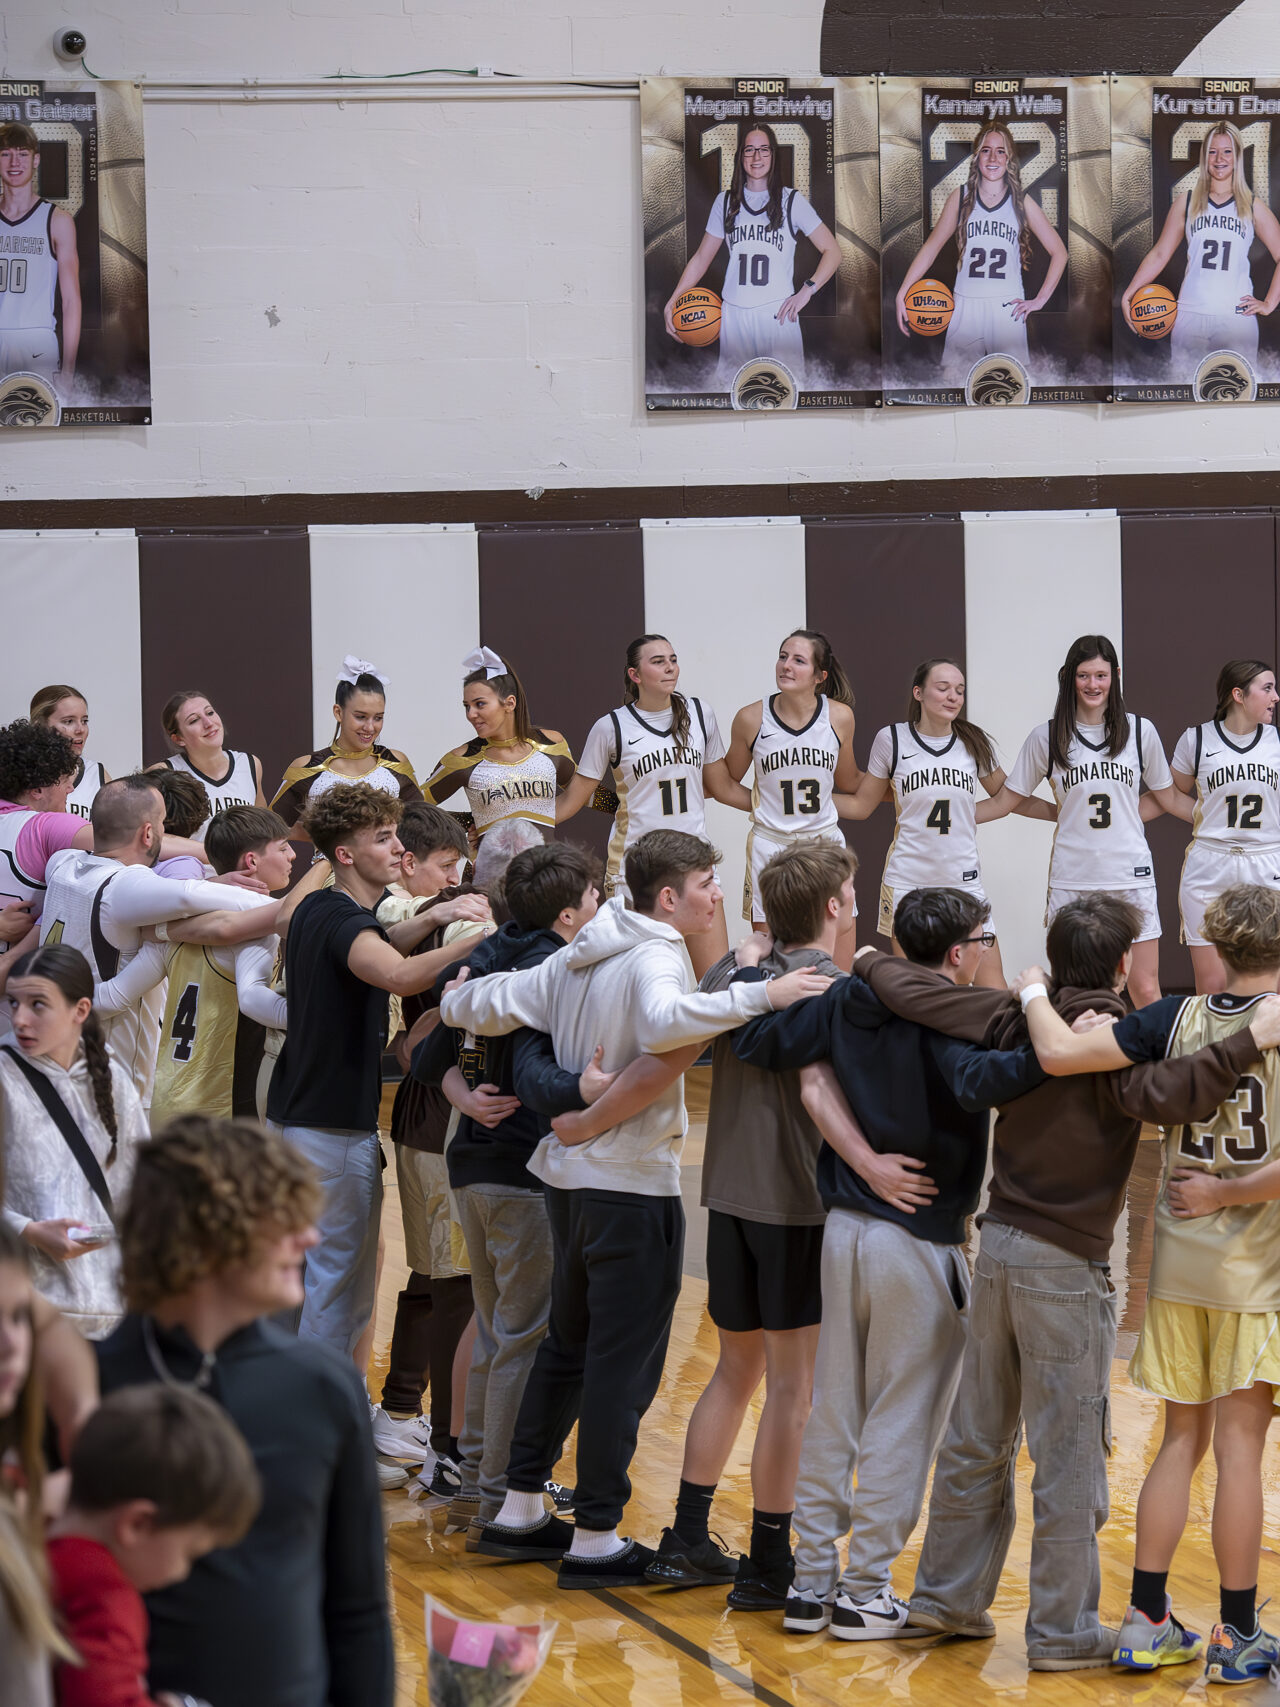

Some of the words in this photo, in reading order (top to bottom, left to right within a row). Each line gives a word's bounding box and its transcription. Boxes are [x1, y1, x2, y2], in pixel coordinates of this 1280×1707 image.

[0, 84, 40, 97] ENIOR
[737, 81, 784, 93] SENIOR
[974, 81, 1019, 93] SENIOR
[1204, 81, 1250, 93] SENIOR
[25, 98, 97, 121] Gaiser
[684, 94, 750, 121] Megan
[753, 95, 832, 121] Schwing
[1152, 93, 1235, 115] Kurstin
[0, 235, 44, 255] ARCHS
[1201, 239, 1231, 271] 21
[738, 253, 770, 286] 10
[968, 247, 1007, 279] 22
[675, 293, 710, 309] Wilson
[913, 296, 948, 308] Wilson
[1134, 303, 1167, 318] Wilson
[680, 310, 707, 325] NCAA
[672, 398, 728, 408] MONARCH
[800, 396, 853, 406] BASKETBALL
[908, 393, 962, 403] MONARCH
[1032, 391, 1085, 401] BASKETBALL
[1137, 389, 1190, 399] MONARCH
[63, 412, 121, 422] BASKETBALL
[632, 746, 702, 781] MONARCHS
[761, 747, 835, 775] MONARCHS
[901, 767, 974, 797] MONARCHS
[1061, 762, 1134, 793] MONARCHS
[1206, 763, 1279, 793] MONARCHS
[480, 780, 555, 806] MNARCHS
[658, 777, 687, 816] 11
[780, 778, 821, 816] 13
[926, 799, 952, 835] 4
[1088, 793, 1112, 829] 3
[1225, 794, 1263, 829] 12
[171, 982, 200, 1062] 4
